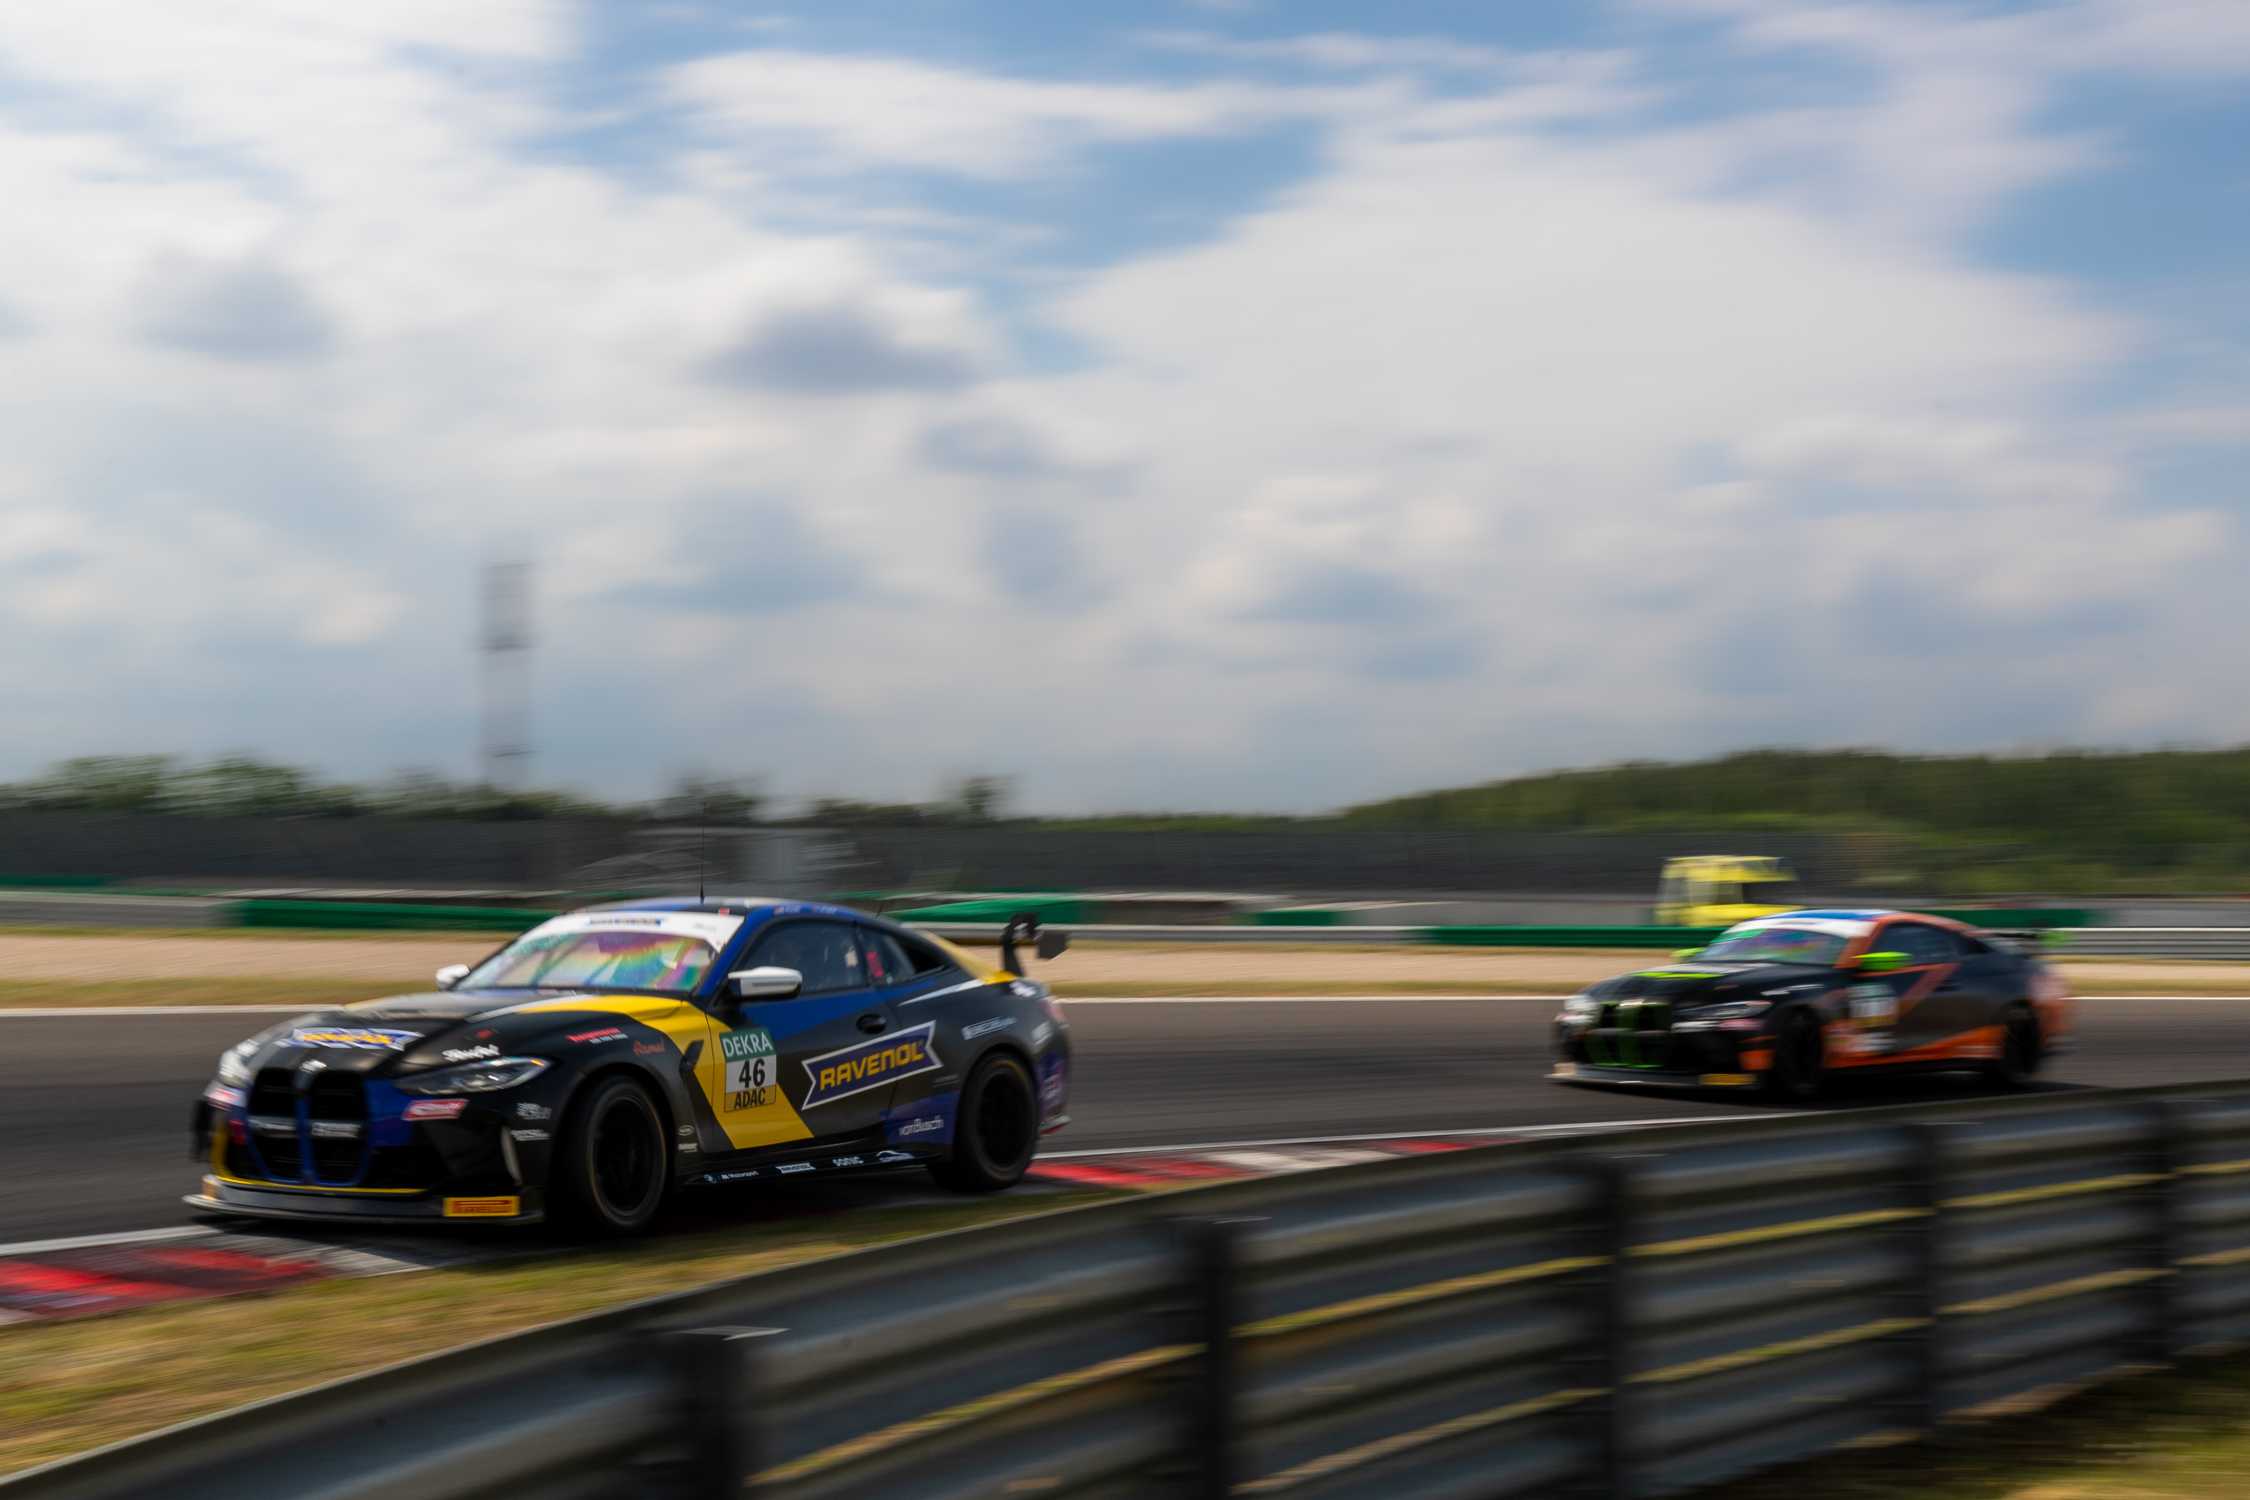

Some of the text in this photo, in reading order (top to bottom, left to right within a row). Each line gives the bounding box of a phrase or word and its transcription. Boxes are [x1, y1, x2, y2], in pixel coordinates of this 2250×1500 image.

[722, 1032, 773, 1057] DEKRA
[739, 1058, 766, 1088] 46
[819, 1041, 924, 1090] RAVENOL
[735, 1088, 766, 1110] ADAC
